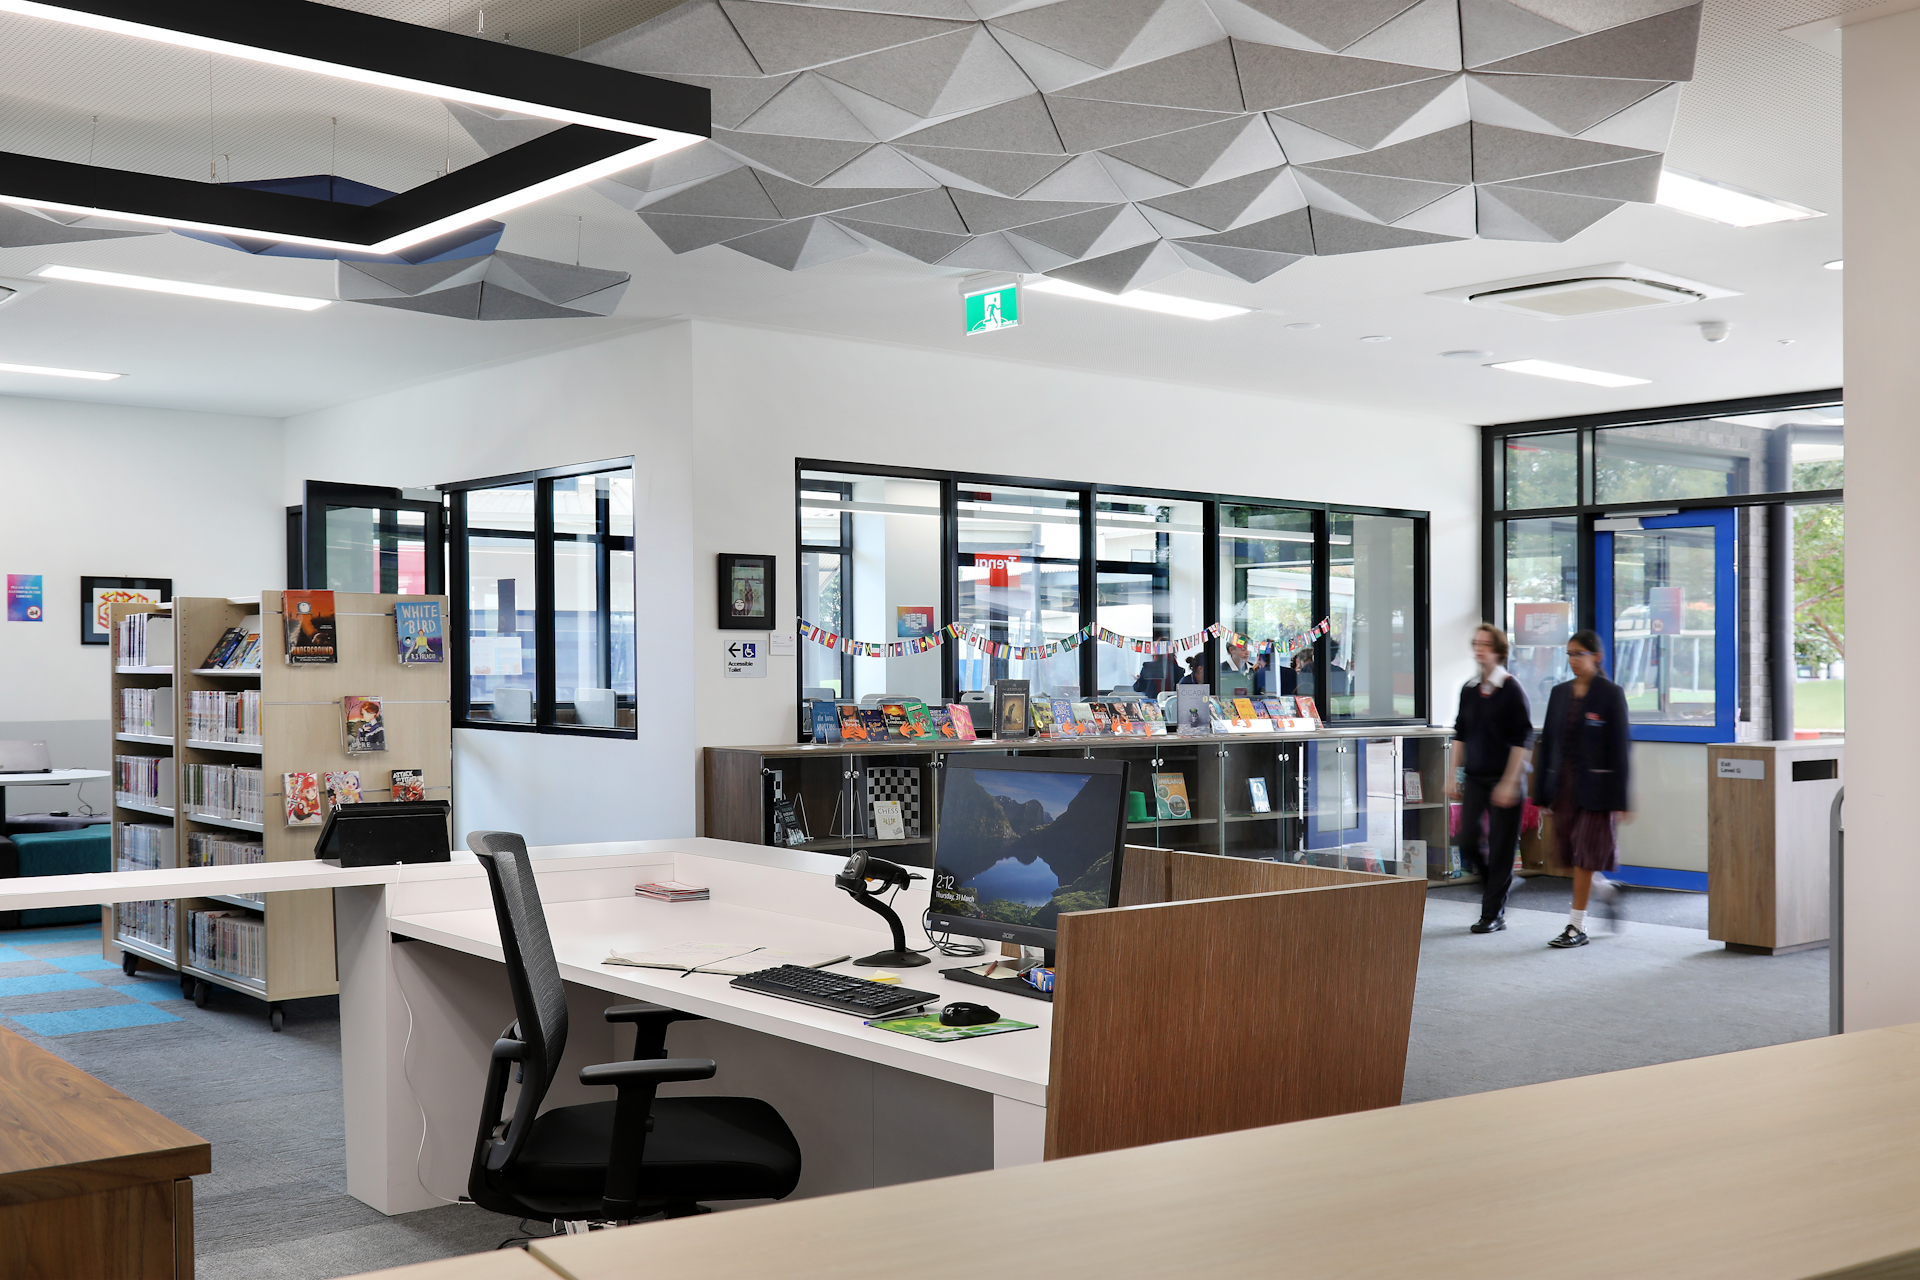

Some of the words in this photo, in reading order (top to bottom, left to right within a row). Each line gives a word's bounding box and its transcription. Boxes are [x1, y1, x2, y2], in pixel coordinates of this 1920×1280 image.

[401, 605, 438, 618] WHITE
[408, 619, 436, 634] BIRD
[290, 646, 334, 656] UNDERGROUND
[393, 770, 413, 778] ATTACK
[877, 807, 899, 815] CHESS
[936, 874, 955, 890] 2:12
[960, 894, 975, 903] March
[1002, 932, 1015, 940] acer
